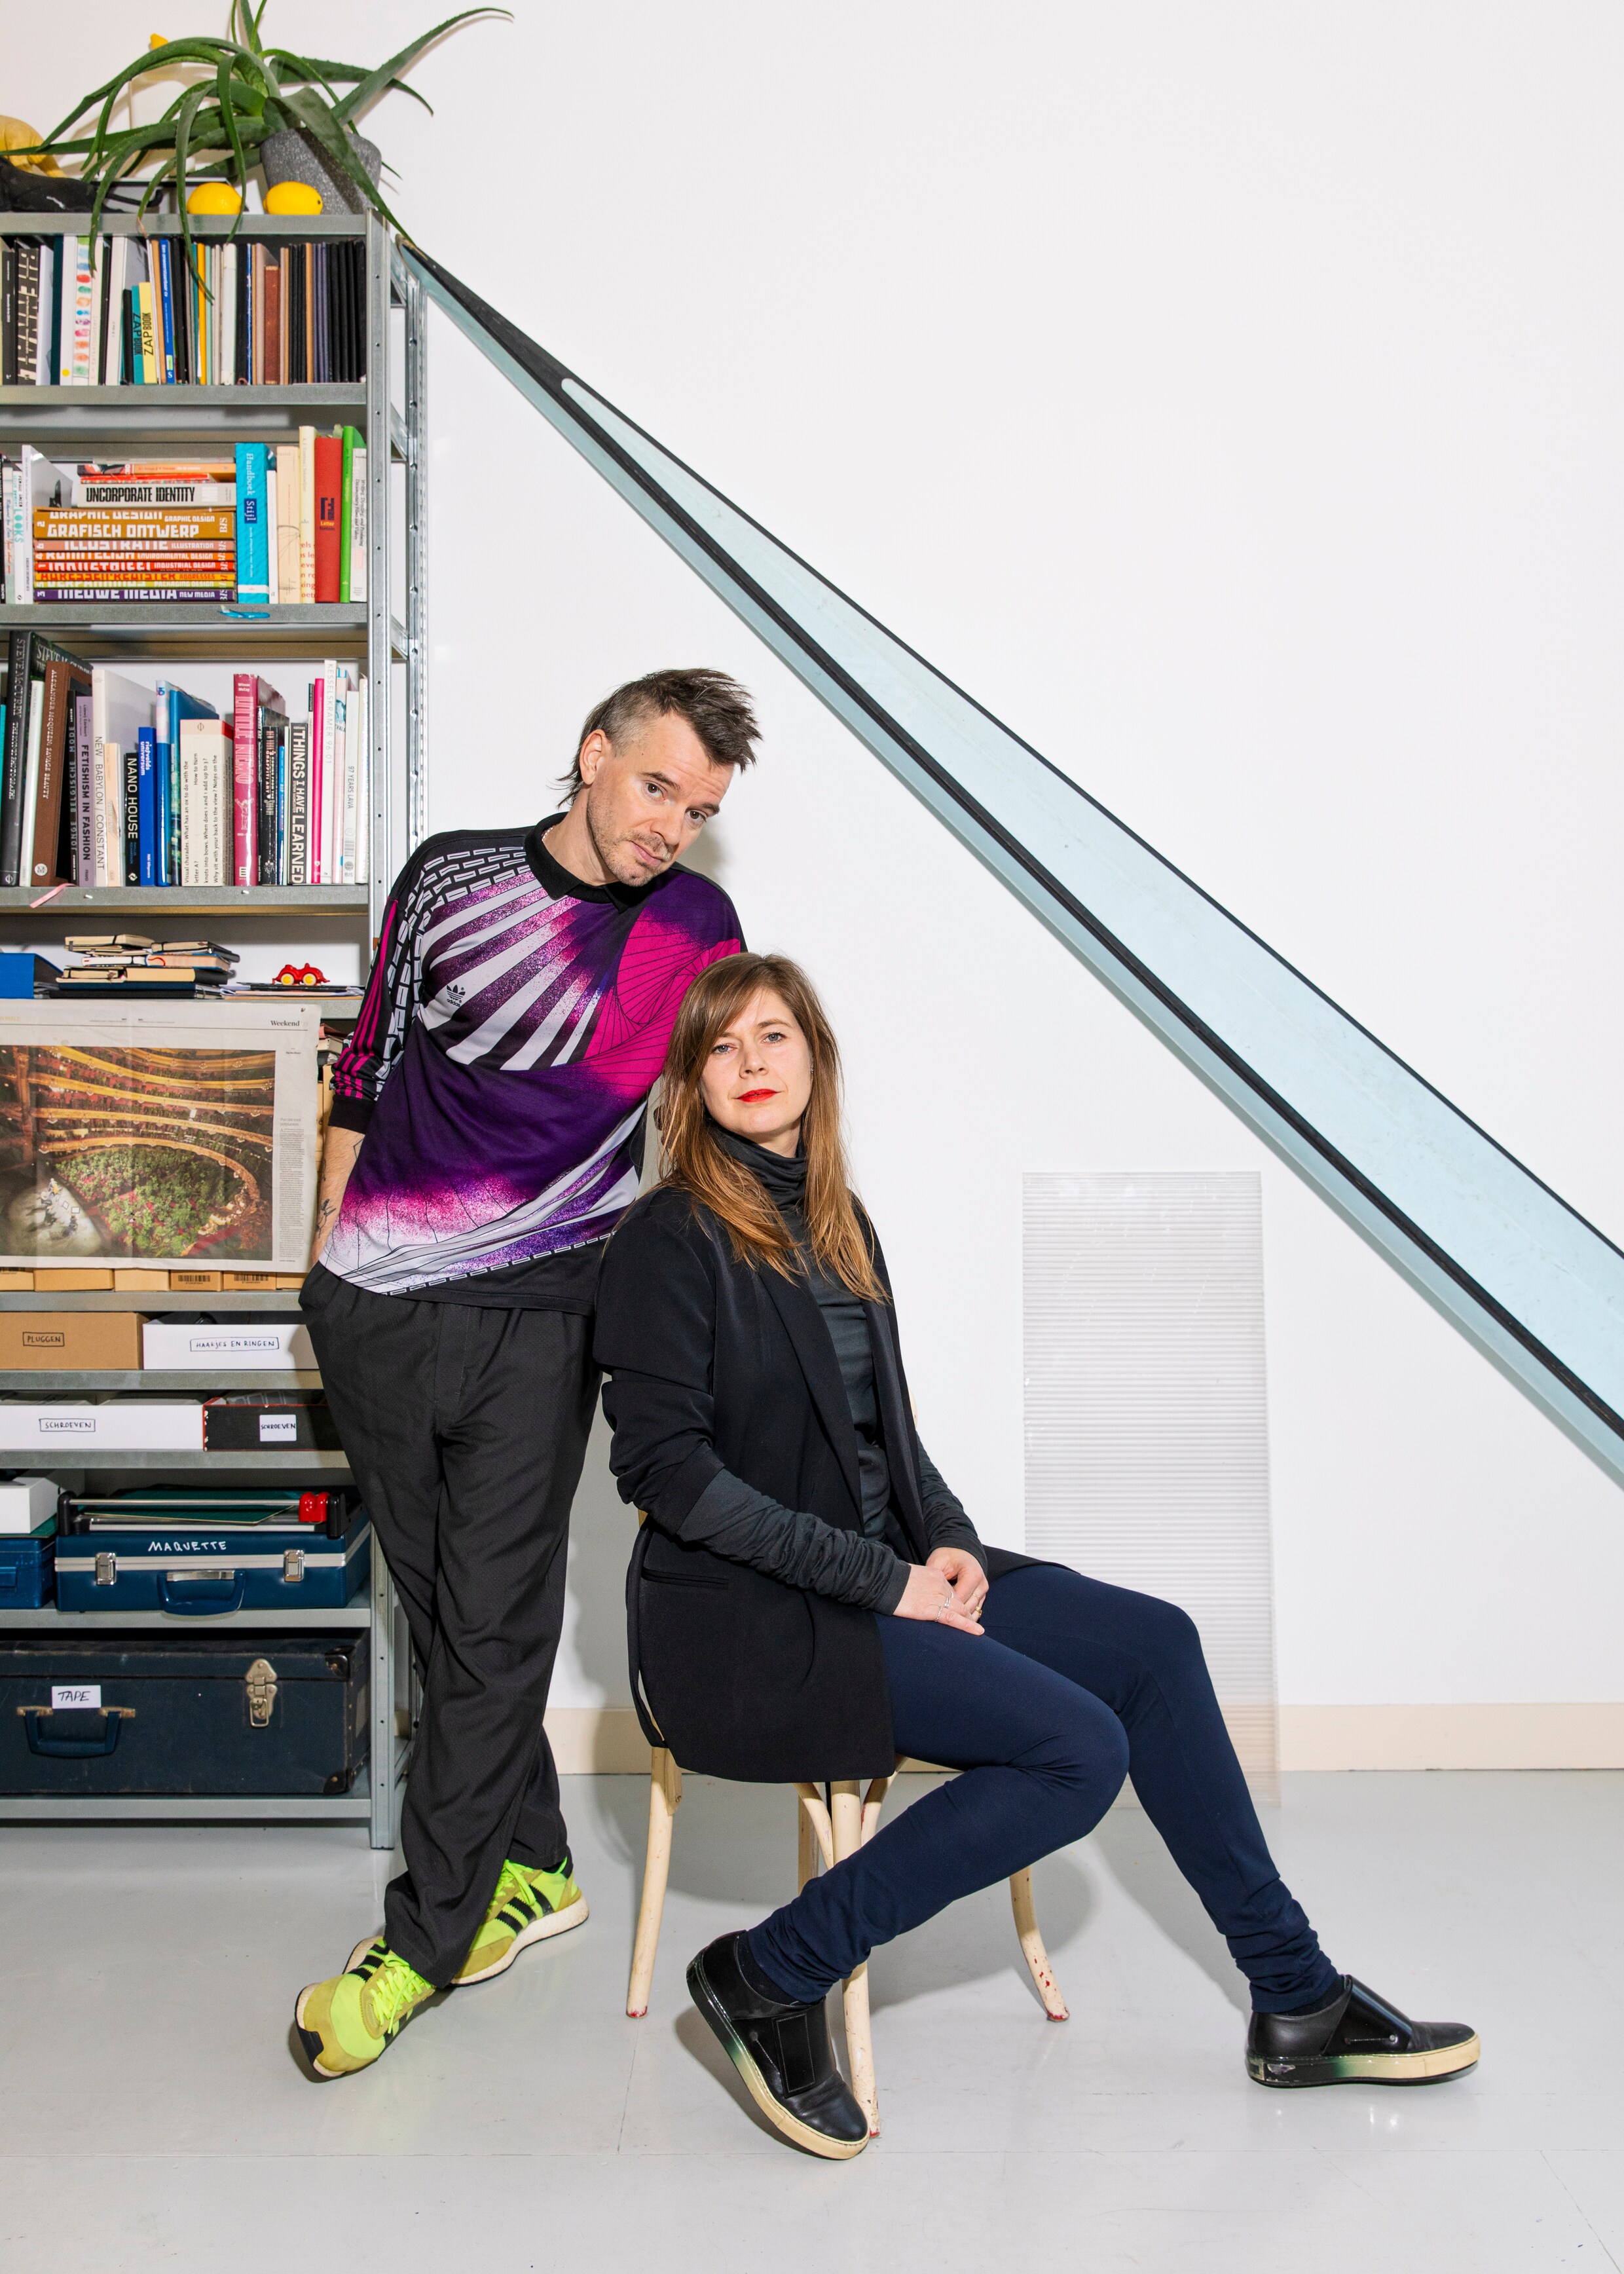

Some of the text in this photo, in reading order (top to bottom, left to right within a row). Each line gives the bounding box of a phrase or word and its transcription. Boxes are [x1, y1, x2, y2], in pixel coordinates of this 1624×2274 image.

[142, 312, 154, 356] ZAP BOOK
[86, 487, 195, 502] UNCORPORATE IDENTITY
[246, 453, 257, 496] Handboek
[13, 509, 24, 543] LOOKS
[47, 524, 199, 538] GRAFISCH ONTWERP
[246, 500, 257, 521] Stijl
[16, 638, 26, 671] STEVE
[12, 671, 24, 718] McCURRY
[48, 669, 58, 710] ALEXANDER
[326, 663, 335, 737] KESSELSKRAMER
[45, 747, 53, 772] SAVAGE
[235, 696, 255, 785] LITTLE NEMO
[293, 730, 306, 779] THINGS
[81, 745, 90, 798] FETISHISM
[95, 764, 104, 805] BABYLON
[83, 802, 90, 813] IN
[127, 758, 138, 839] NANO HOUSE
[296, 789, 305, 813] HAVE
[96, 814, 105, 870] CONSTANT
[291, 815, 305, 884] LEARNED
[447, 999, 460, 1007] adidas
[147, 1540, 227, 1552] MAQUETTE
[58, 1690, 91, 1702] TAPE
